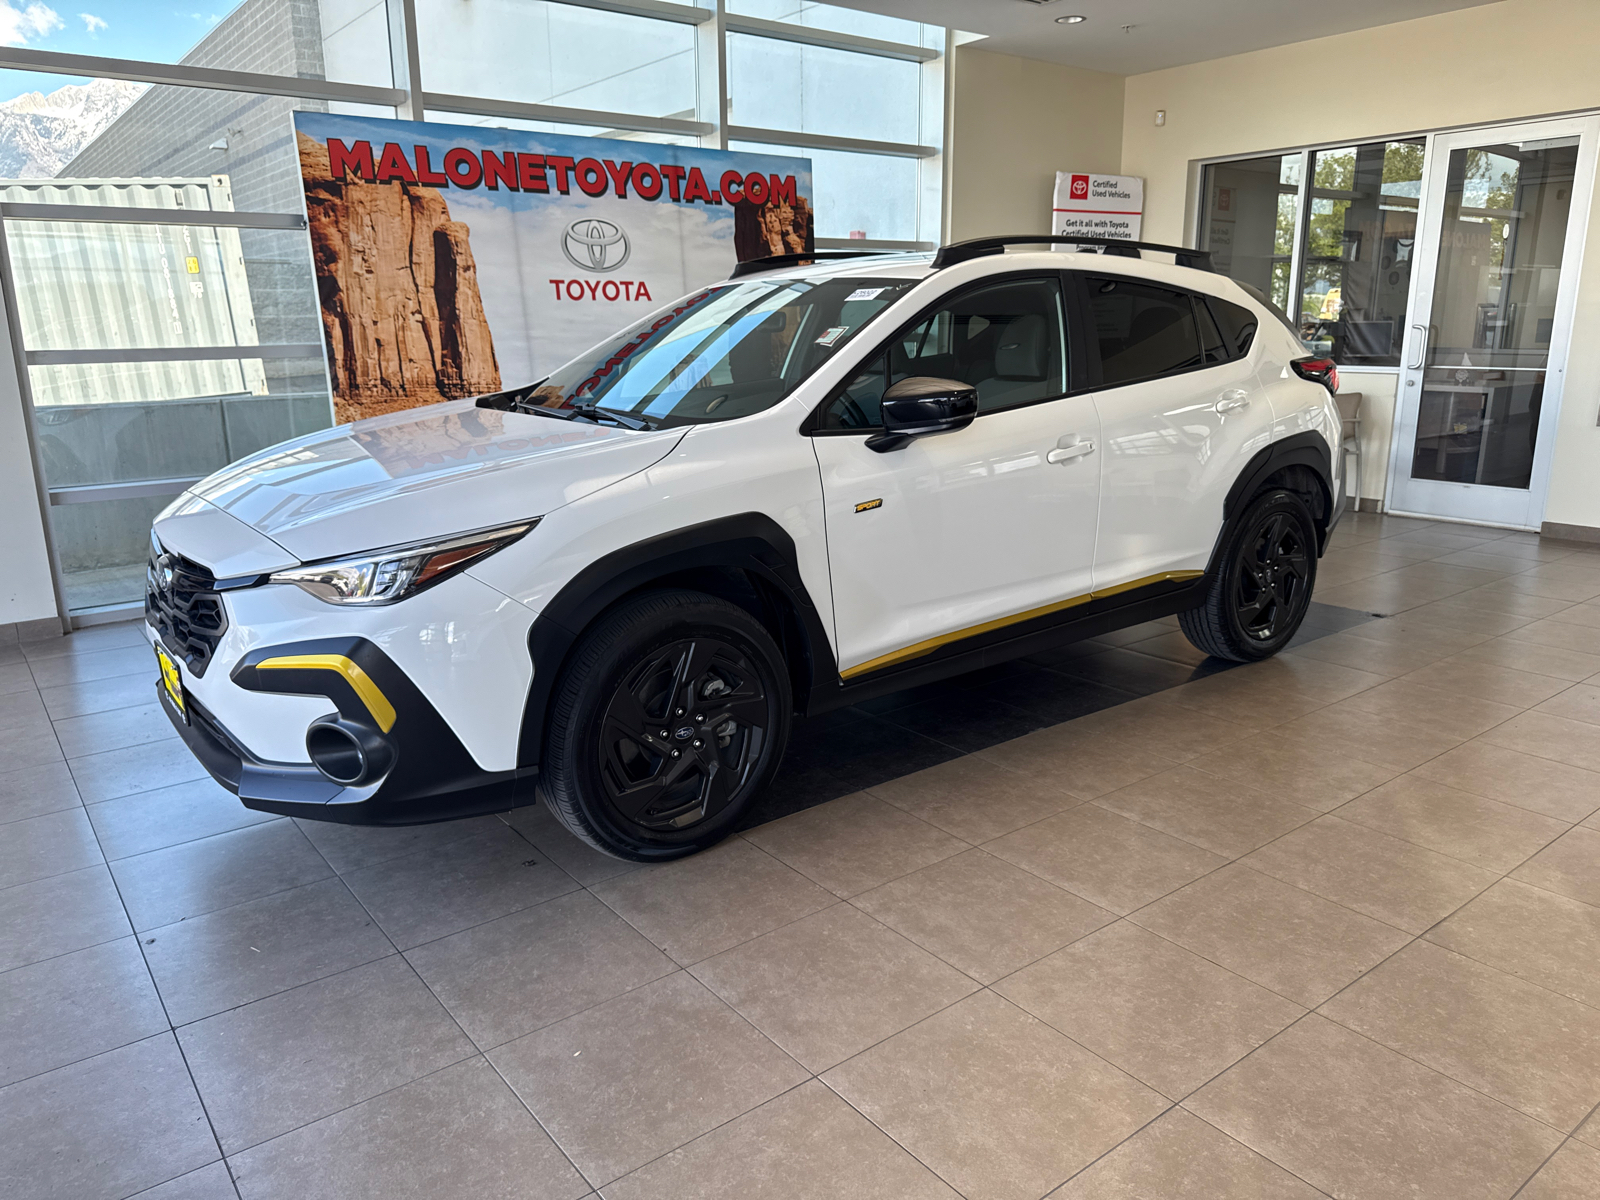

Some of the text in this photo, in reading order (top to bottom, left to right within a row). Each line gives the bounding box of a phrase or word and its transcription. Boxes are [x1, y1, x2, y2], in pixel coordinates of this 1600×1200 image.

[327, 137, 797, 207] MALONETOYOTA.COM
[1093, 180, 1118, 188] Certified
[1092, 190, 1130, 199] Used Vehicles
[1066, 219, 1129, 230] Get it all with Toyota
[1061, 229, 1131, 239] Certified Used Vehicles
[550, 279, 652, 301] TOYOTA
[856, 499, 881, 511] SPORT
